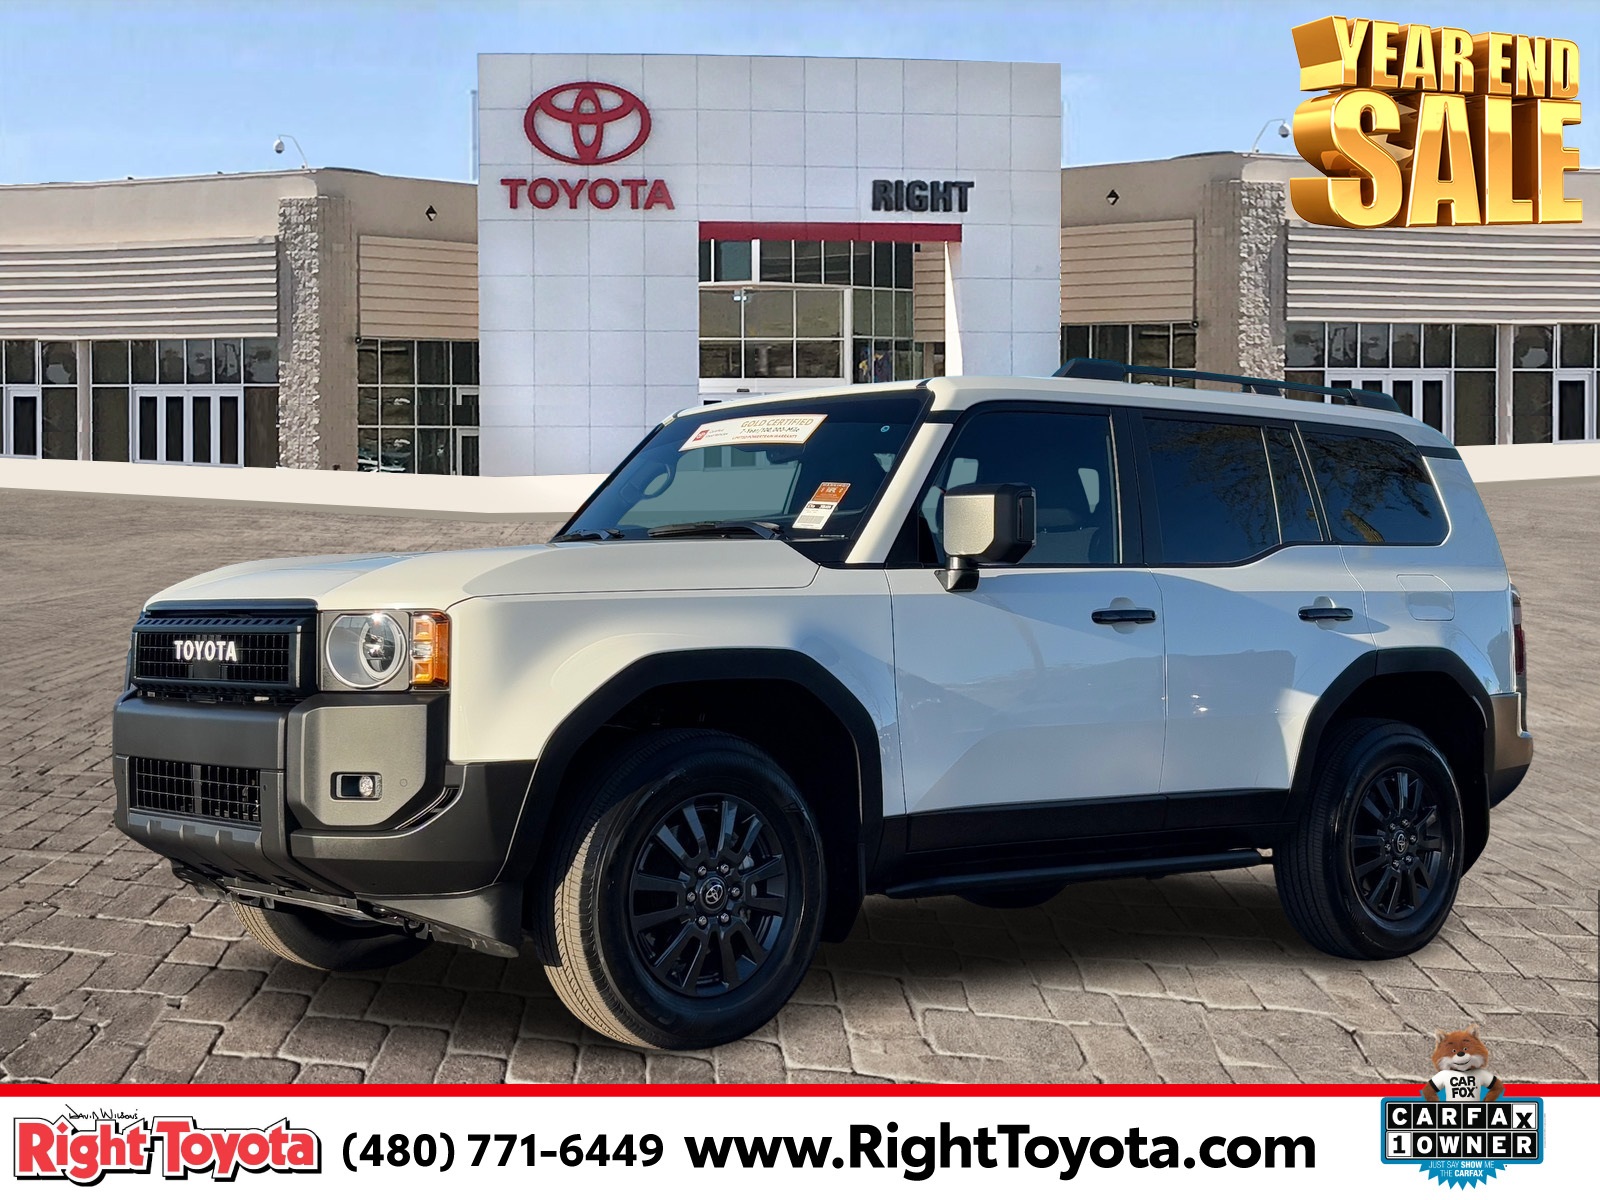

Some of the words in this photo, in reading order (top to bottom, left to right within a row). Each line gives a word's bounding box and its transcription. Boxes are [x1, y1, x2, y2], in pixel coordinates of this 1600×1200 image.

[501, 178, 675, 210] TOYOTA
[872, 179, 975, 213] RIGHT
[741, 419, 768, 428] GOLD
[768, 417, 815, 426] CERTIFIED
[174, 639, 238, 662] TOYOTA
